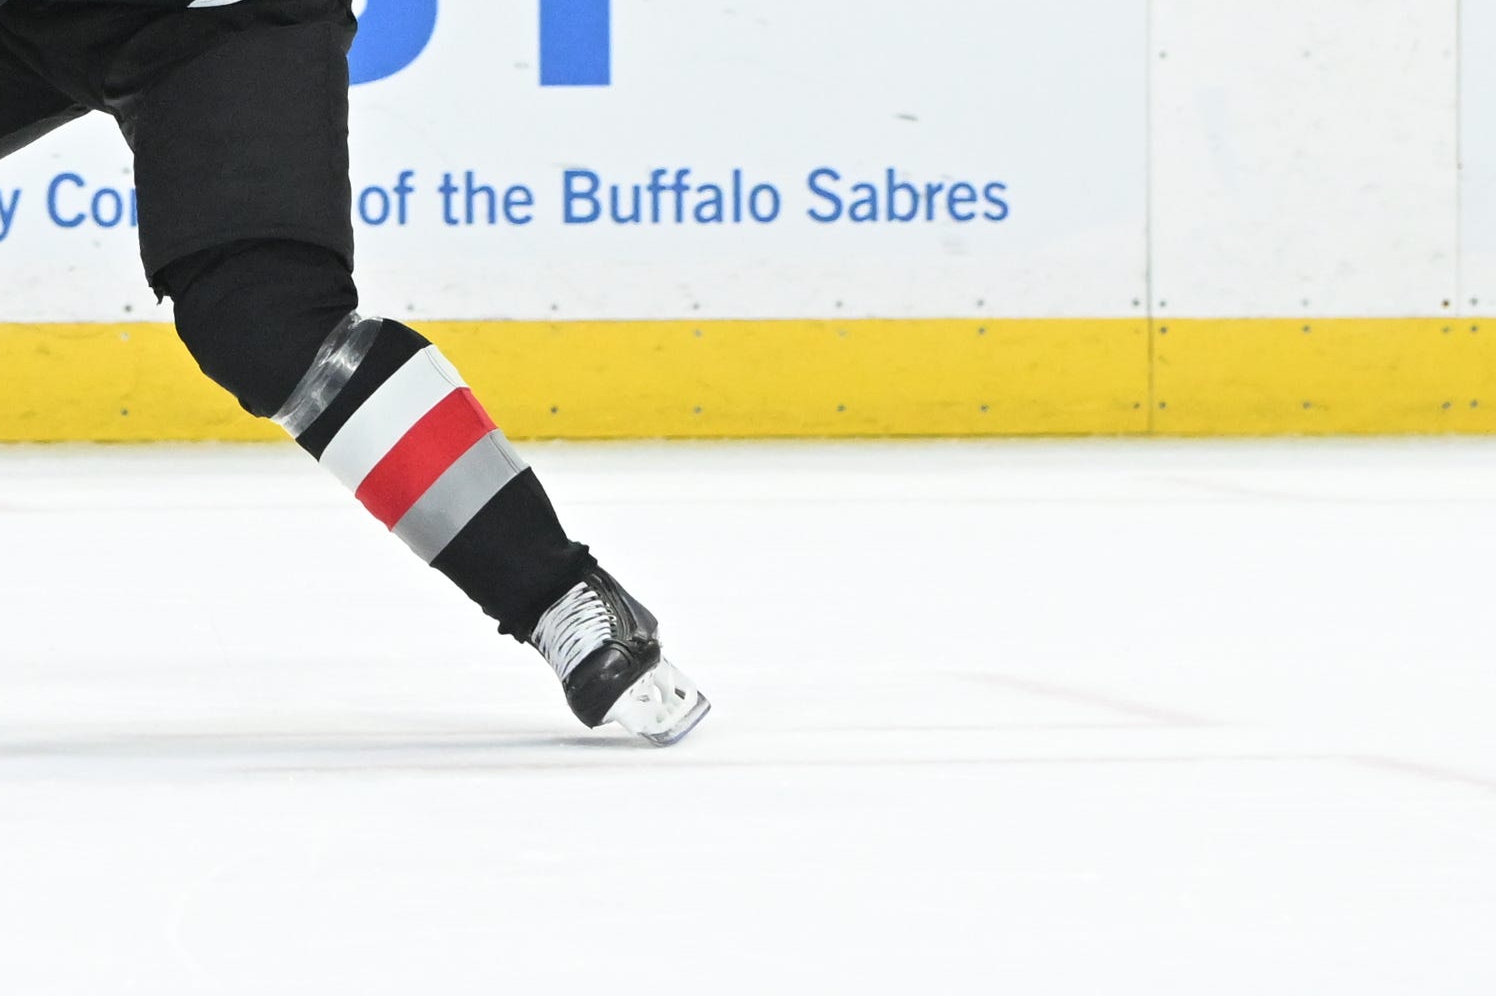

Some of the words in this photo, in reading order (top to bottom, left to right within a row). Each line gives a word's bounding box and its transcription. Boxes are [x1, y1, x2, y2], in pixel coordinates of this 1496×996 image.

[45, 171, 138, 229] Co
[356, 168, 416, 226] of
[437, 169, 535, 226] the
[562, 166, 782, 225] Buffalo
[807, 165, 1010, 223] Sabres
